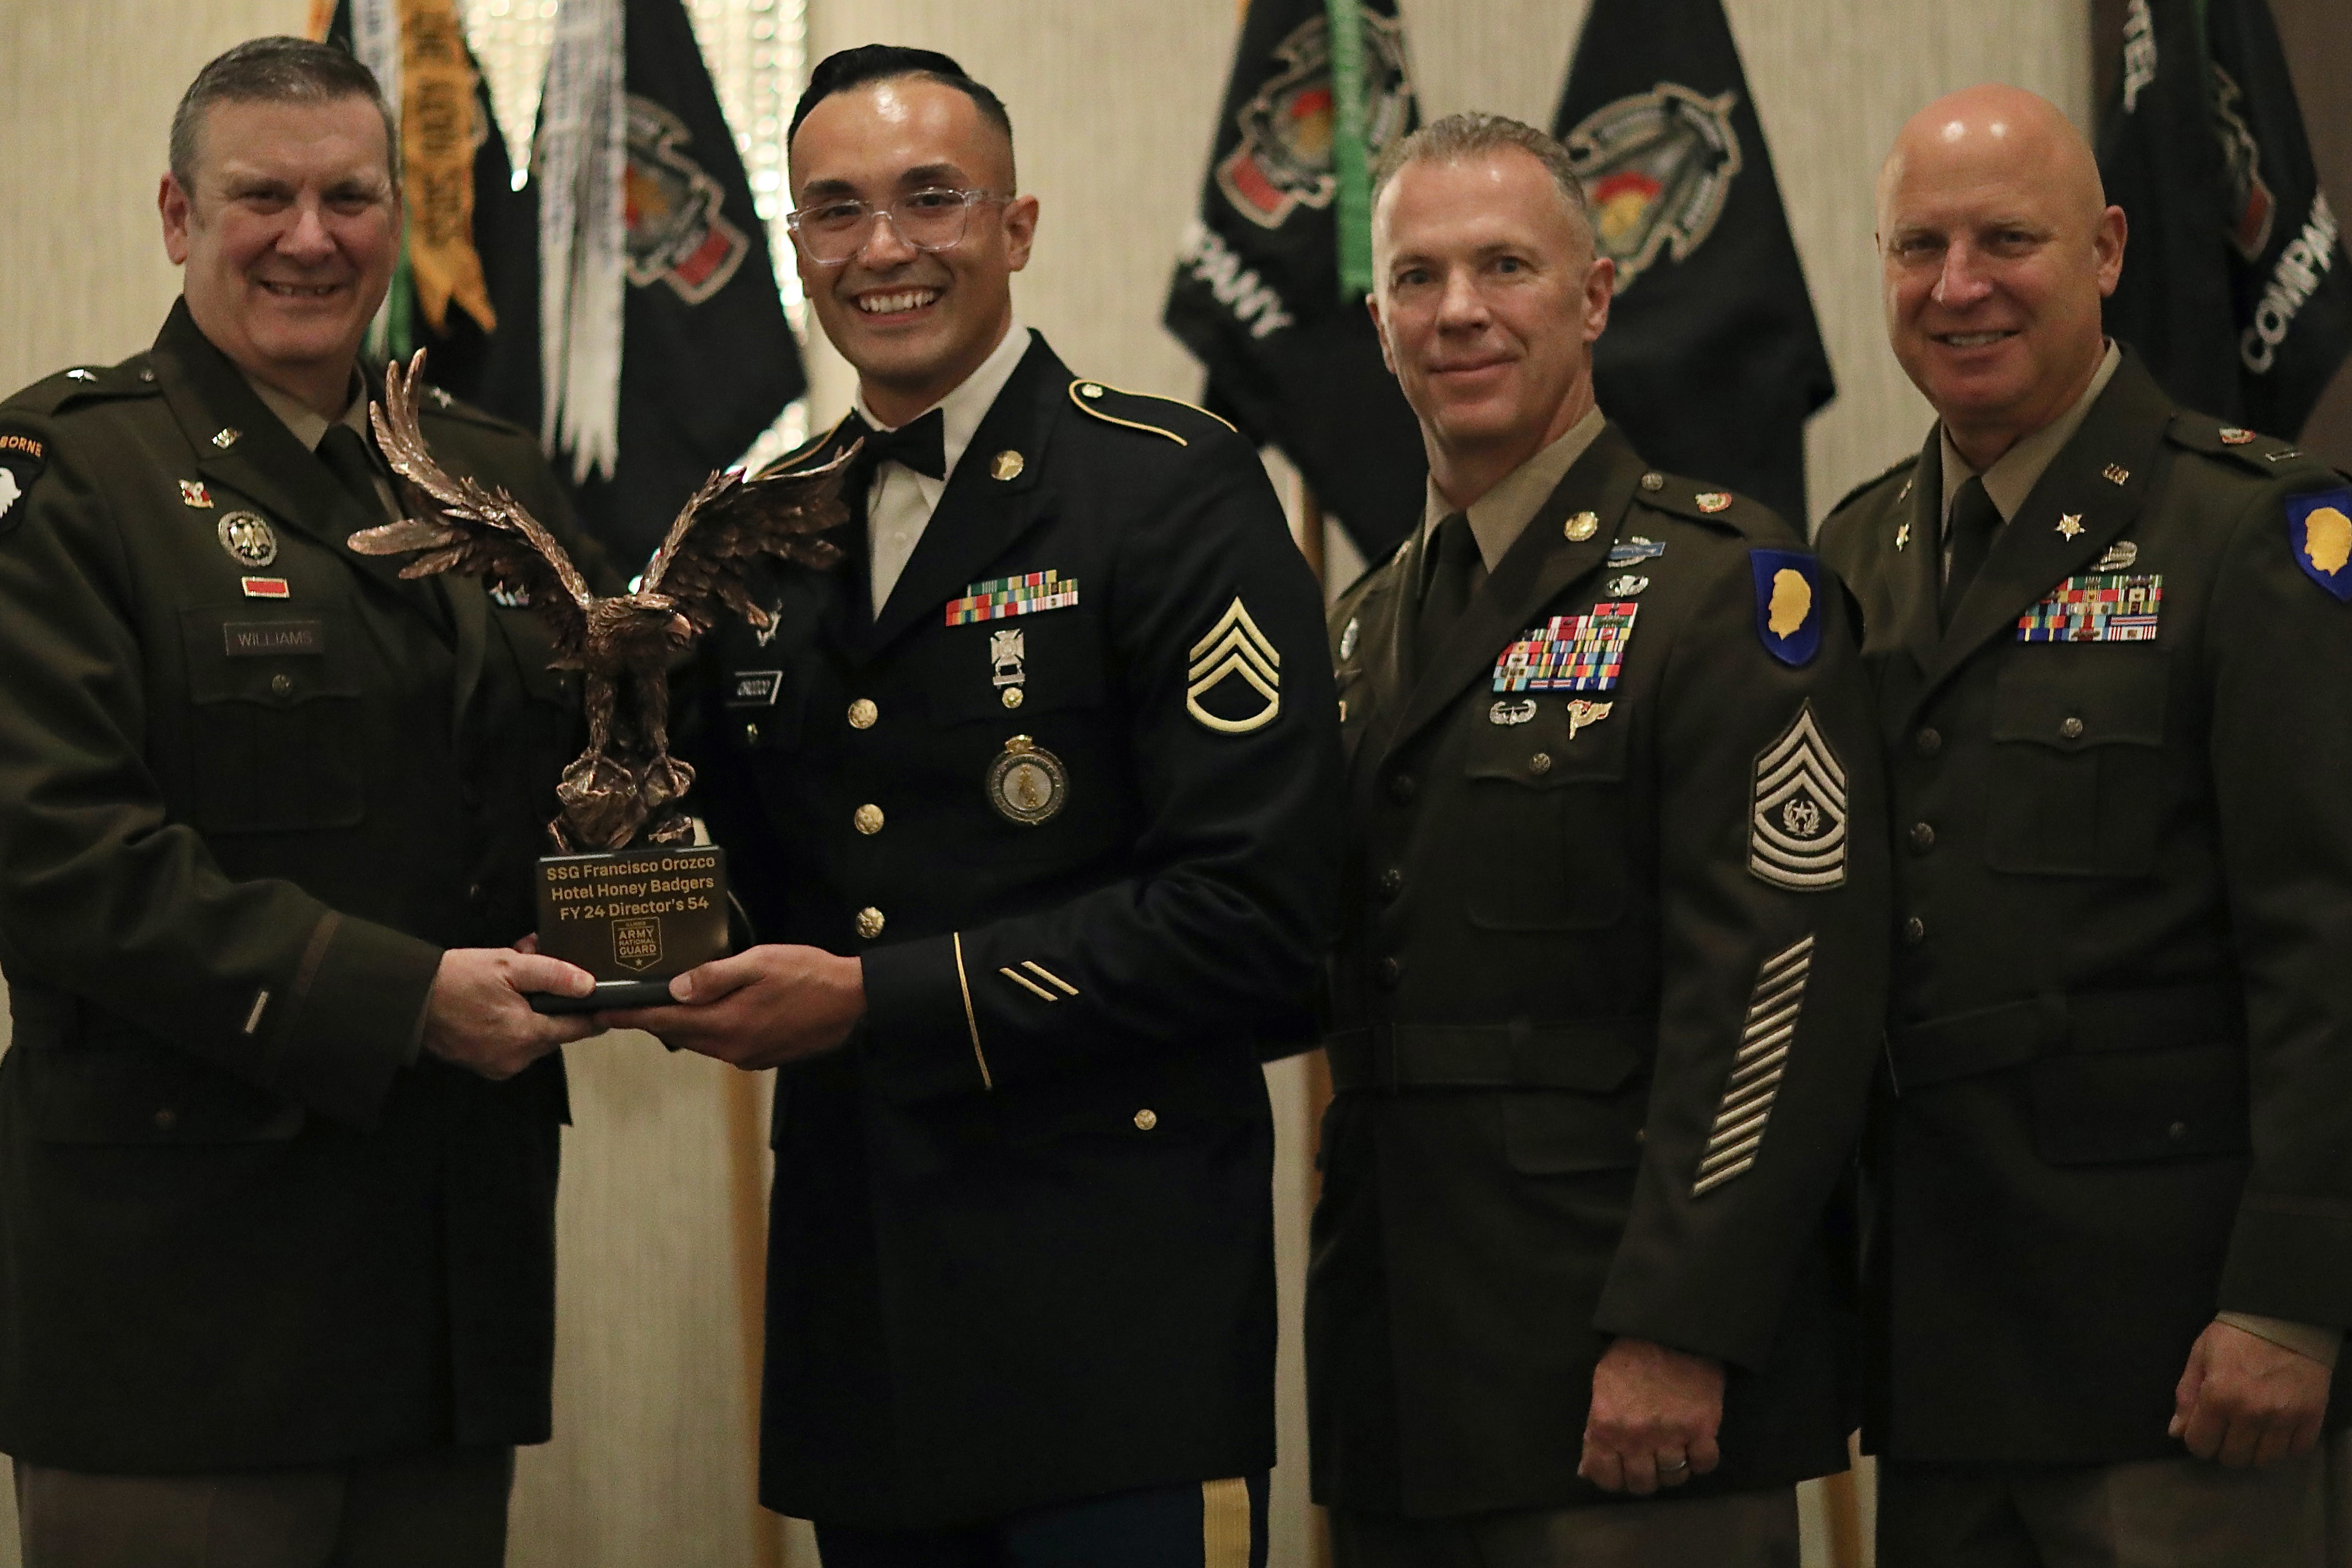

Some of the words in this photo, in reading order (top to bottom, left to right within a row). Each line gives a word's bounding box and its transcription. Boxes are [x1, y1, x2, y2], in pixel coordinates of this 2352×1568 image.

[547, 867, 579, 881] SSG
[584, 860, 658, 878] Francisco
[662, 856, 715, 871] Orozco
[551, 884, 594, 901] Hotel
[597, 880, 647, 898] Honey
[651, 876, 714, 893] Badgers
[560, 906, 580, 921] FY
[584, 905, 605, 919] 24
[609, 899, 684, 917] Director's
[687, 896, 709, 910] 54
[619, 929, 654, 939] ARMY
[619, 944, 656, 954] GUARD
